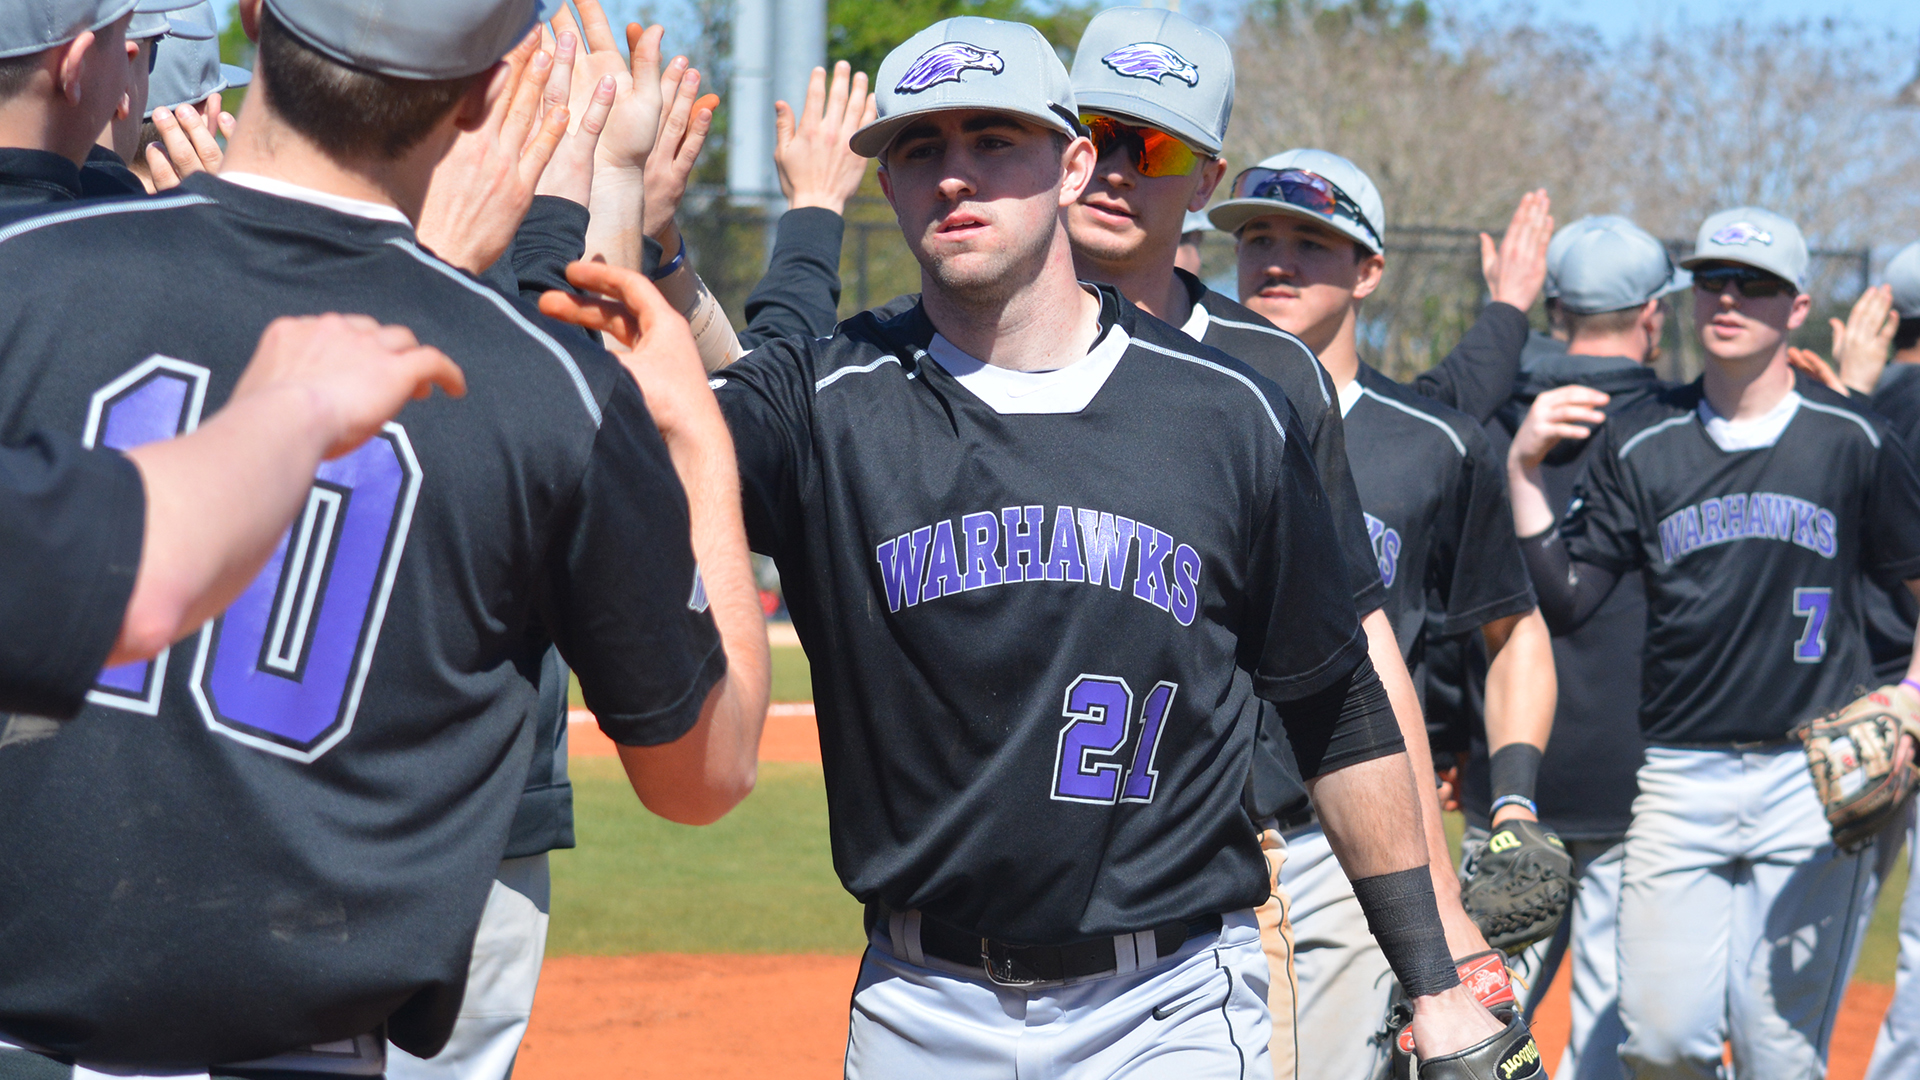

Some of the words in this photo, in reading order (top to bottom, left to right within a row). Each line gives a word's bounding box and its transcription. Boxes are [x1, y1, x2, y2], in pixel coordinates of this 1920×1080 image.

[876, 504, 1202, 626] WARHAWKS
[1657, 491, 1838, 565] WARHAWKS
[1792, 586, 1833, 664] 7
[1049, 672, 1179, 806] 21
[1467, 968, 1506, 997] Rawling
